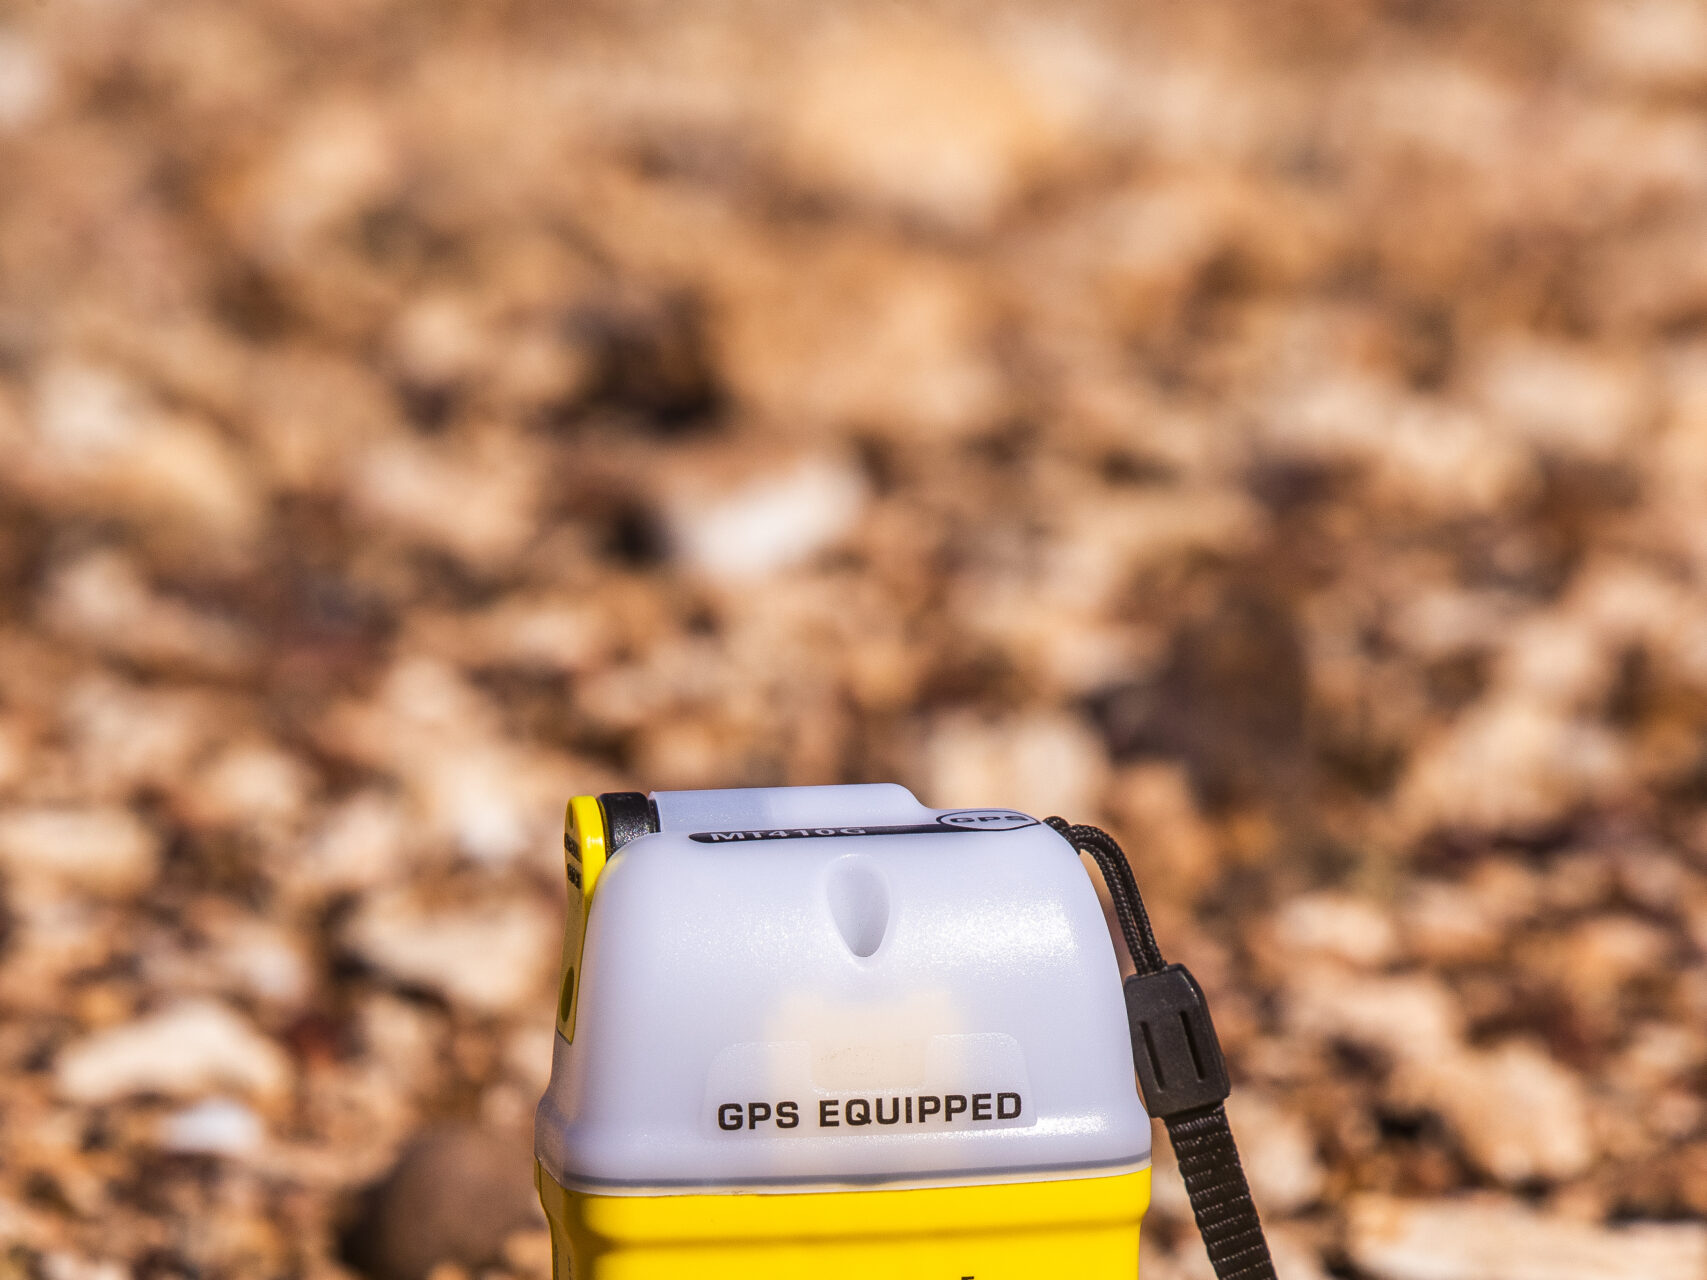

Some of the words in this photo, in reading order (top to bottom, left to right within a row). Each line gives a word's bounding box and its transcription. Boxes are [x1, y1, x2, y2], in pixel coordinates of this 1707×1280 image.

[950, 815, 1029, 824] GPS
[710, 827, 866, 841] MT410G
[718, 1101, 800, 1131] GPS
[819, 1092, 1022, 1128] EQUIPPED
